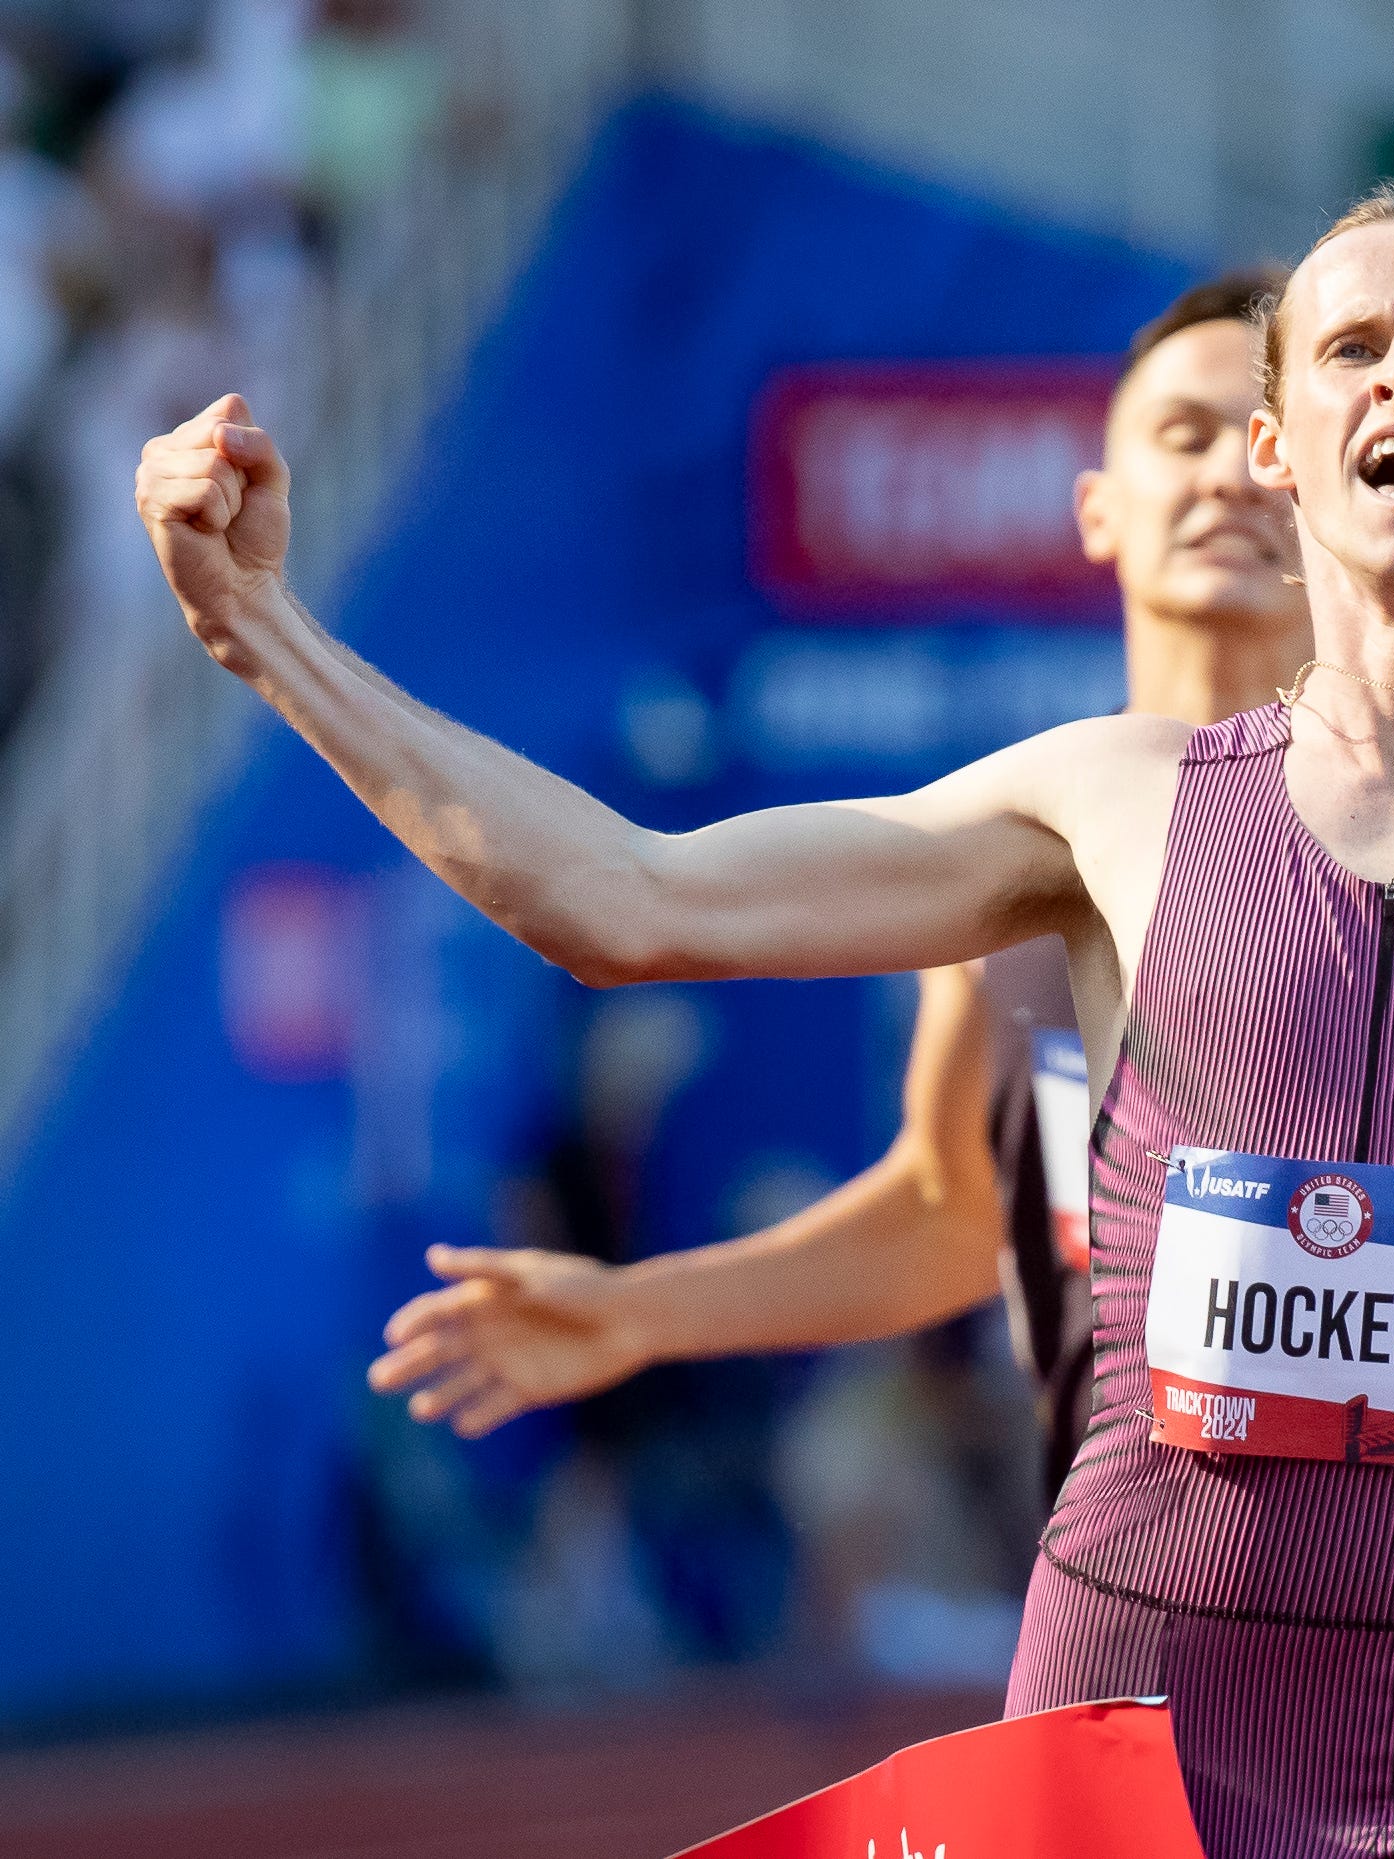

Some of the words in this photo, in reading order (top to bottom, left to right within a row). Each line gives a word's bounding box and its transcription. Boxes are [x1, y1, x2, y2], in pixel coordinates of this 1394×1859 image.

[1208, 1176, 1271, 1200] USATF
[1299, 1175, 1332, 1196] UNITED
[1335, 1176, 1367, 1201] STATES
[1296, 1233, 1333, 1257] OLYMPIC
[1337, 1238, 1361, 1256] TEAM
[1200, 1415, 1248, 1441] 2024
